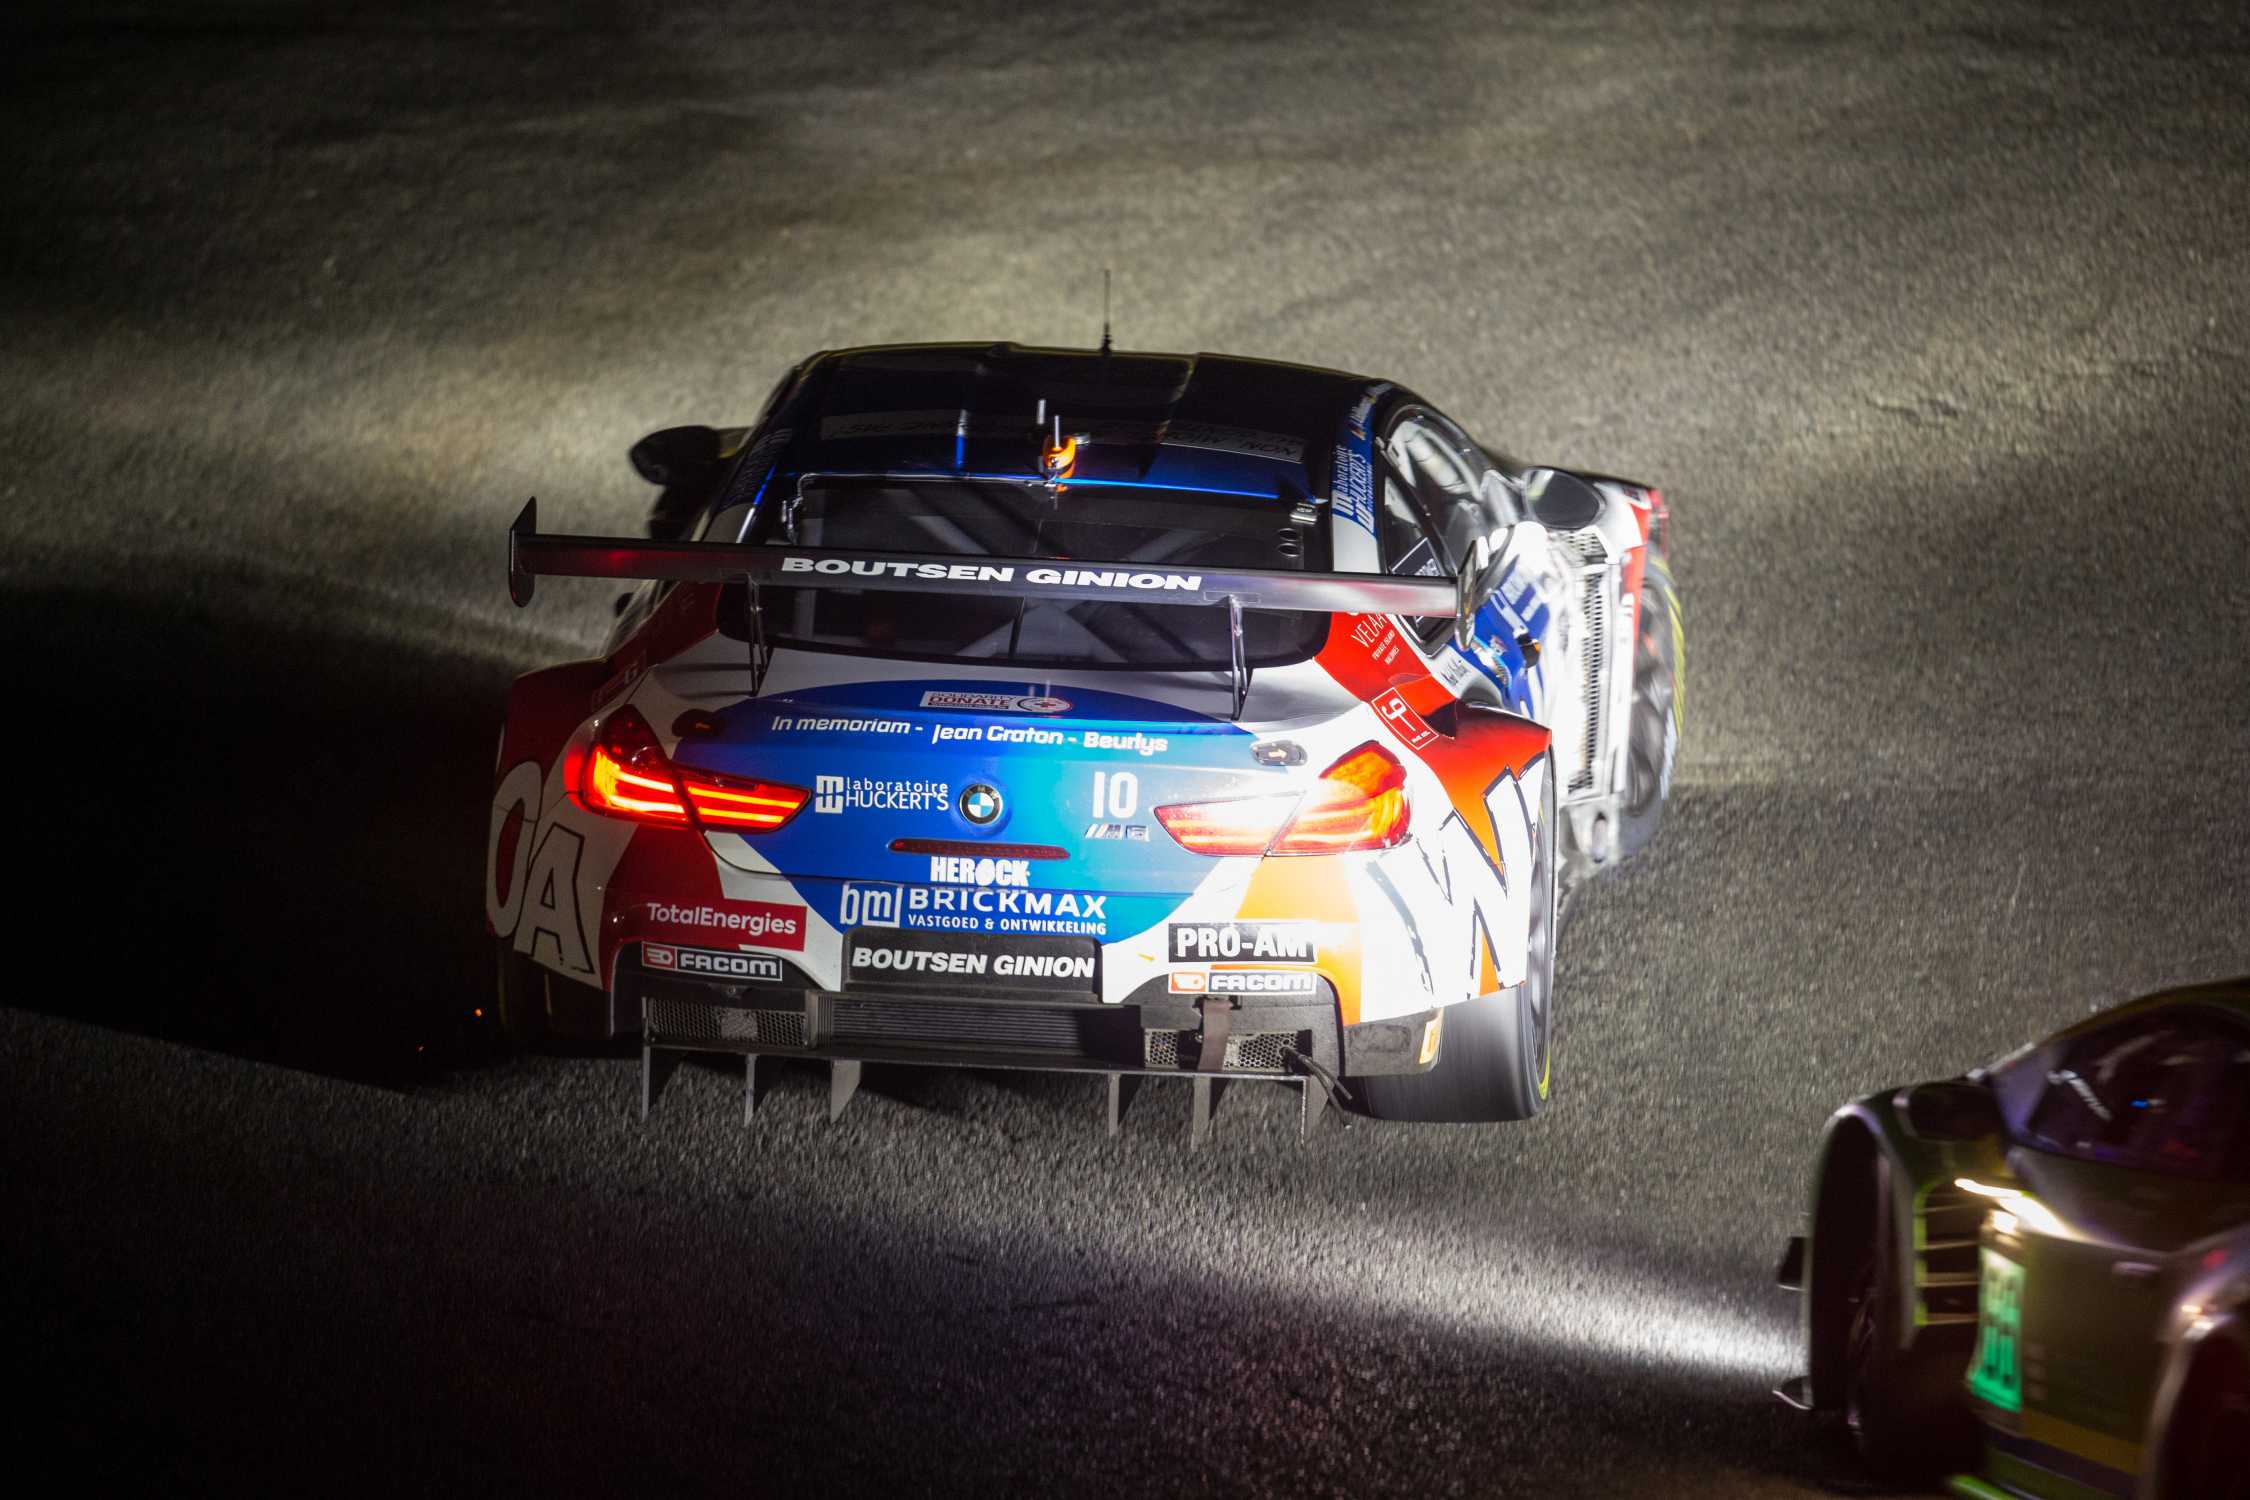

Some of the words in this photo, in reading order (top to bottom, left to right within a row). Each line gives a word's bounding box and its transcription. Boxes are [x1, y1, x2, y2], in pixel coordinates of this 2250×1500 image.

[781, 557, 1014, 582] BOUTSEN
[1026, 568, 1202, 591] GINION
[929, 696, 1009, 706] DONATE
[771, 716, 793, 731] In
[796, 718, 910, 734] memoriam
[932, 724, 982, 744] Jean
[987, 725, 1064, 745] Graton
[1083, 731, 1168, 756] Beurlys
[845, 789, 950, 812] HUCKERT'S
[846, 776, 949, 795] laboratoire
[1092, 771, 1138, 819] 10
[930, 855, 1031, 887] HEROCK
[646, 902, 798, 937] TotalEnergies
[908, 887, 1107, 920] BRICKMAX
[907, 914, 979, 930] VASTGOED
[984, 917, 994, 931] &
[1000, 917, 1107, 936] ONTWIKKELING
[1176, 926, 1316, 958] PRO-AM
[680, 952, 778, 976] FACOM
[851, 946, 988, 975] BOUTSEN
[993, 954, 1096, 978] GINION
[1210, 973, 1314, 991] FACOM
